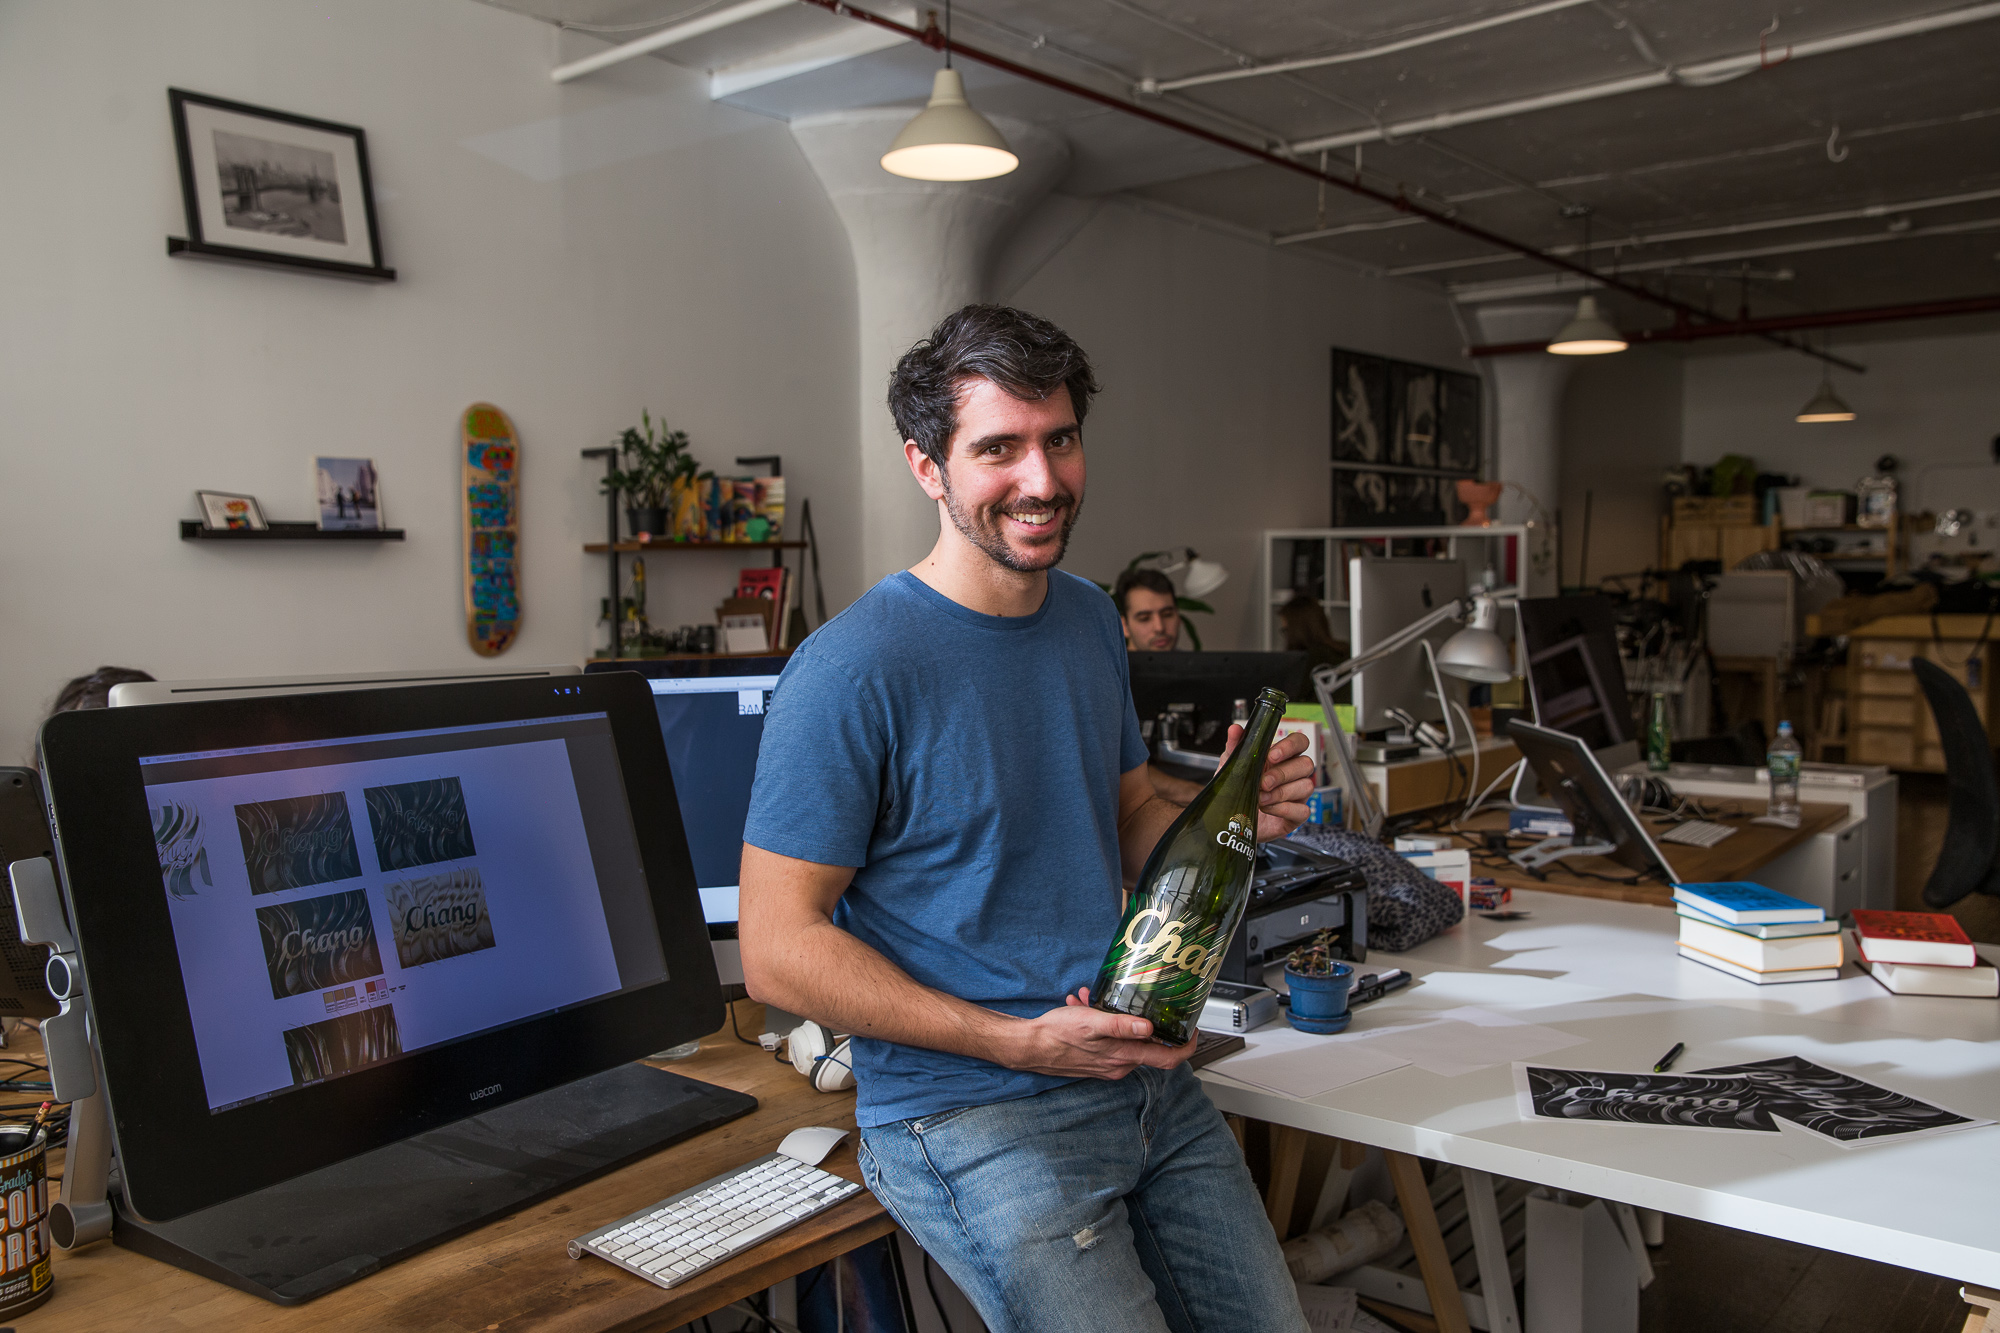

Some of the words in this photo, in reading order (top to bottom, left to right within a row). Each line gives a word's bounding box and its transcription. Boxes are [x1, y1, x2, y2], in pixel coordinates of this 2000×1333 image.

[1216, 830, 1255, 861] Chang
[404, 902, 477, 936] Chang
[278, 926, 364, 963] Chang
[470, 1084, 502, 1101] wacom
[1563, 1086, 1740, 1112] Chang
[0, 1215, 50, 1274] REW
[4, 1279, 29, 1294] COFFEE
